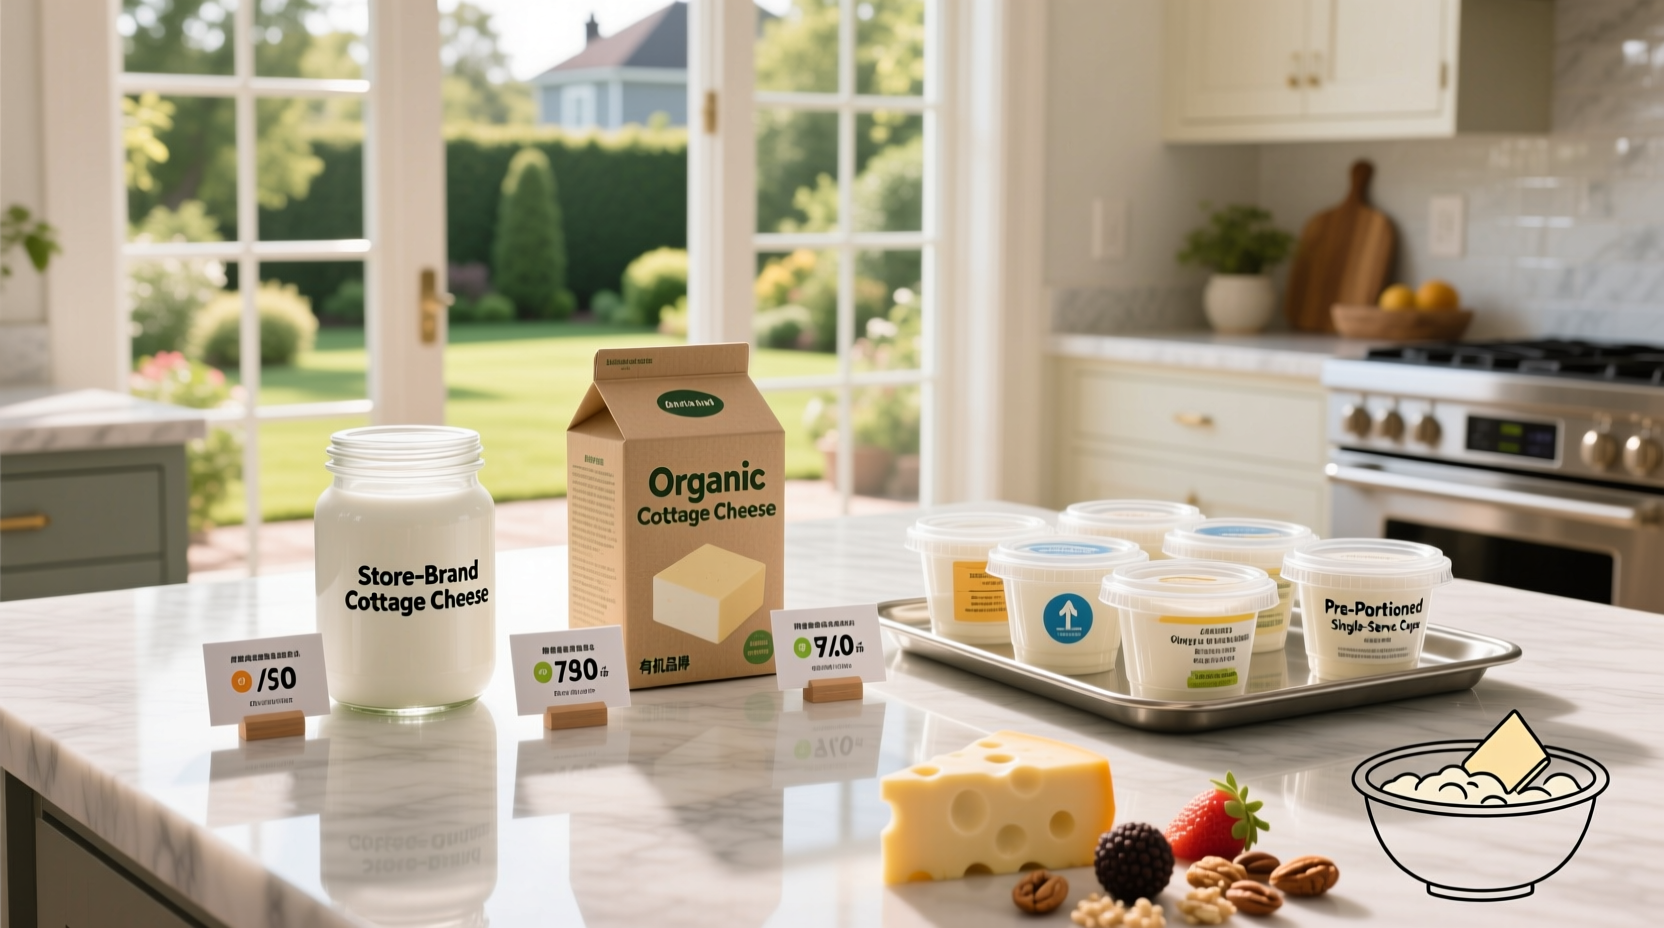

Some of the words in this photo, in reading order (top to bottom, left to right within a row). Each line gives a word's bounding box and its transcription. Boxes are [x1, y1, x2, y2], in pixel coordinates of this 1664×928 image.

[649, 460, 766, 504] Organic
[637, 506, 710, 527] Cottage
[714, 501, 777, 521] Cheese
[358, 559, 479, 586] Store-Brand
[345, 590, 426, 617] Cottage
[430, 587, 489, 610] Cheese
[1325, 597, 1424, 617] Pre-Portioned
[554, 657, 598, 683] 790
